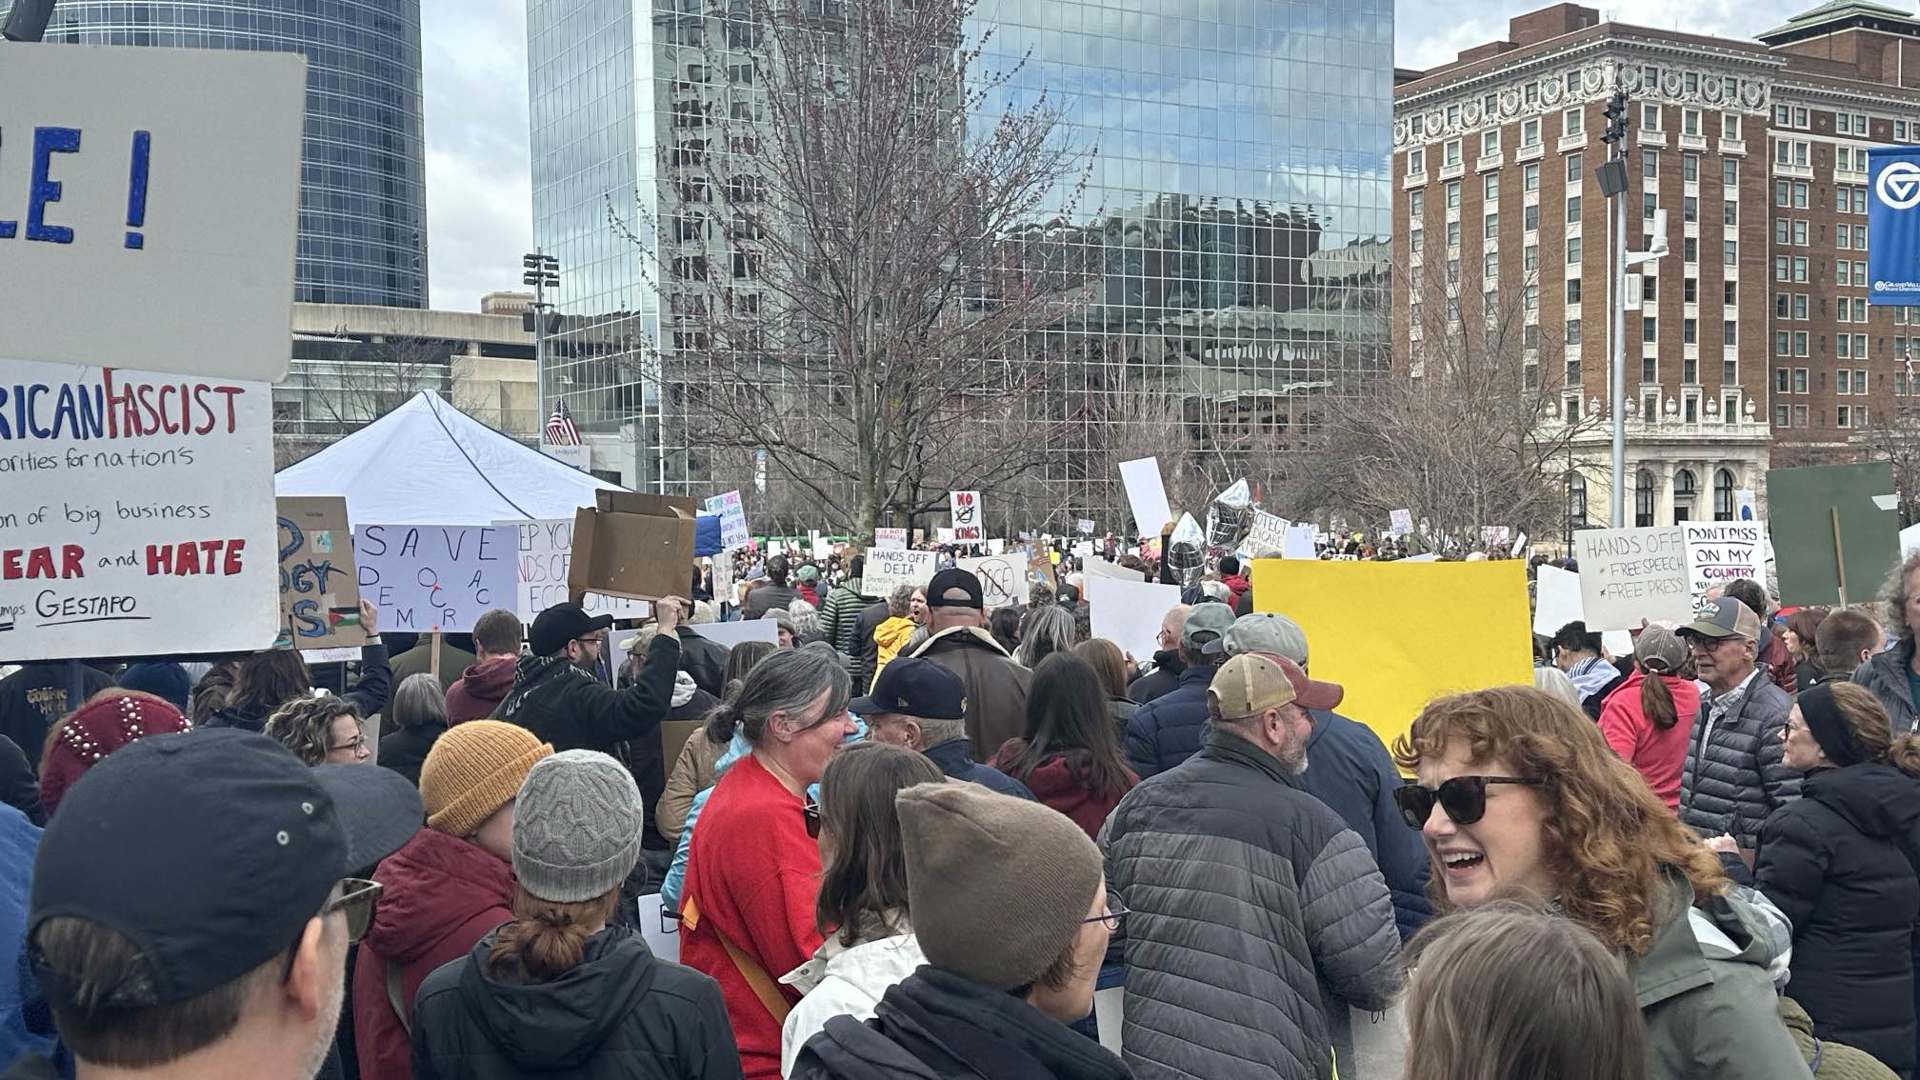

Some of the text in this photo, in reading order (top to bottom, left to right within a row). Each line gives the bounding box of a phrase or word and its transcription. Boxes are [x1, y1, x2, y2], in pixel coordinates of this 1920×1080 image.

[103, 367, 246, 439] FASCIST
[66, 448, 89, 469] for
[95, 446, 194, 468] nation's
[957, 493, 973, 506] NO
[27, 506, 48, 525] of
[64, 503, 101, 534] big
[116, 500, 211, 520] business
[361, 525, 498, 561] SAVE
[955, 526, 980, 540] KINGS
[1729, 527, 1758, 541] PISS
[1586, 532, 1681, 559] HANDS OFF
[1696, 549, 1753, 563] ON MY
[98, 550, 140, 568] and
[146, 539, 246, 576] HATE
[872, 551, 929, 565] HANDS OFF
[884, 562, 915, 575] DEIA
[1703, 567, 1756, 579] COUNTRY
[1648, 577, 1685, 598] PRESS
[35, 589, 136, 618] GESTAPO
